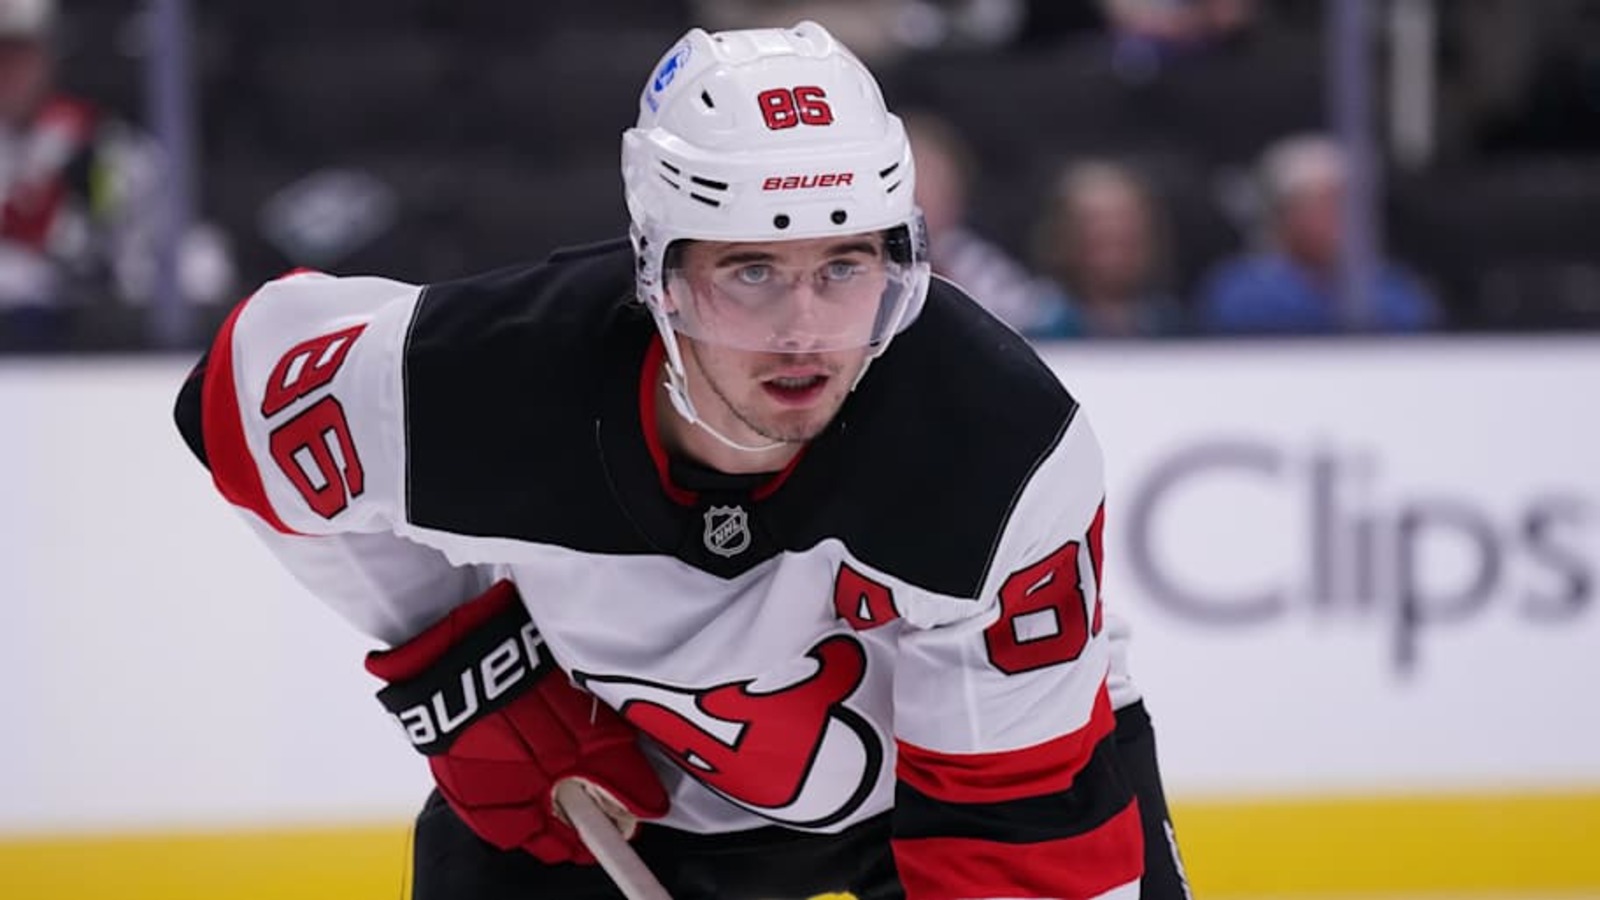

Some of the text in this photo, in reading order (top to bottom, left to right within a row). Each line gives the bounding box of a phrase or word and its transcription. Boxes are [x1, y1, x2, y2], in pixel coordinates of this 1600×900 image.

[757, 86, 834, 131] 86
[762, 172, 854, 191] BAUER
[261, 322, 368, 520] 86
[983, 492, 1105, 676] 8
